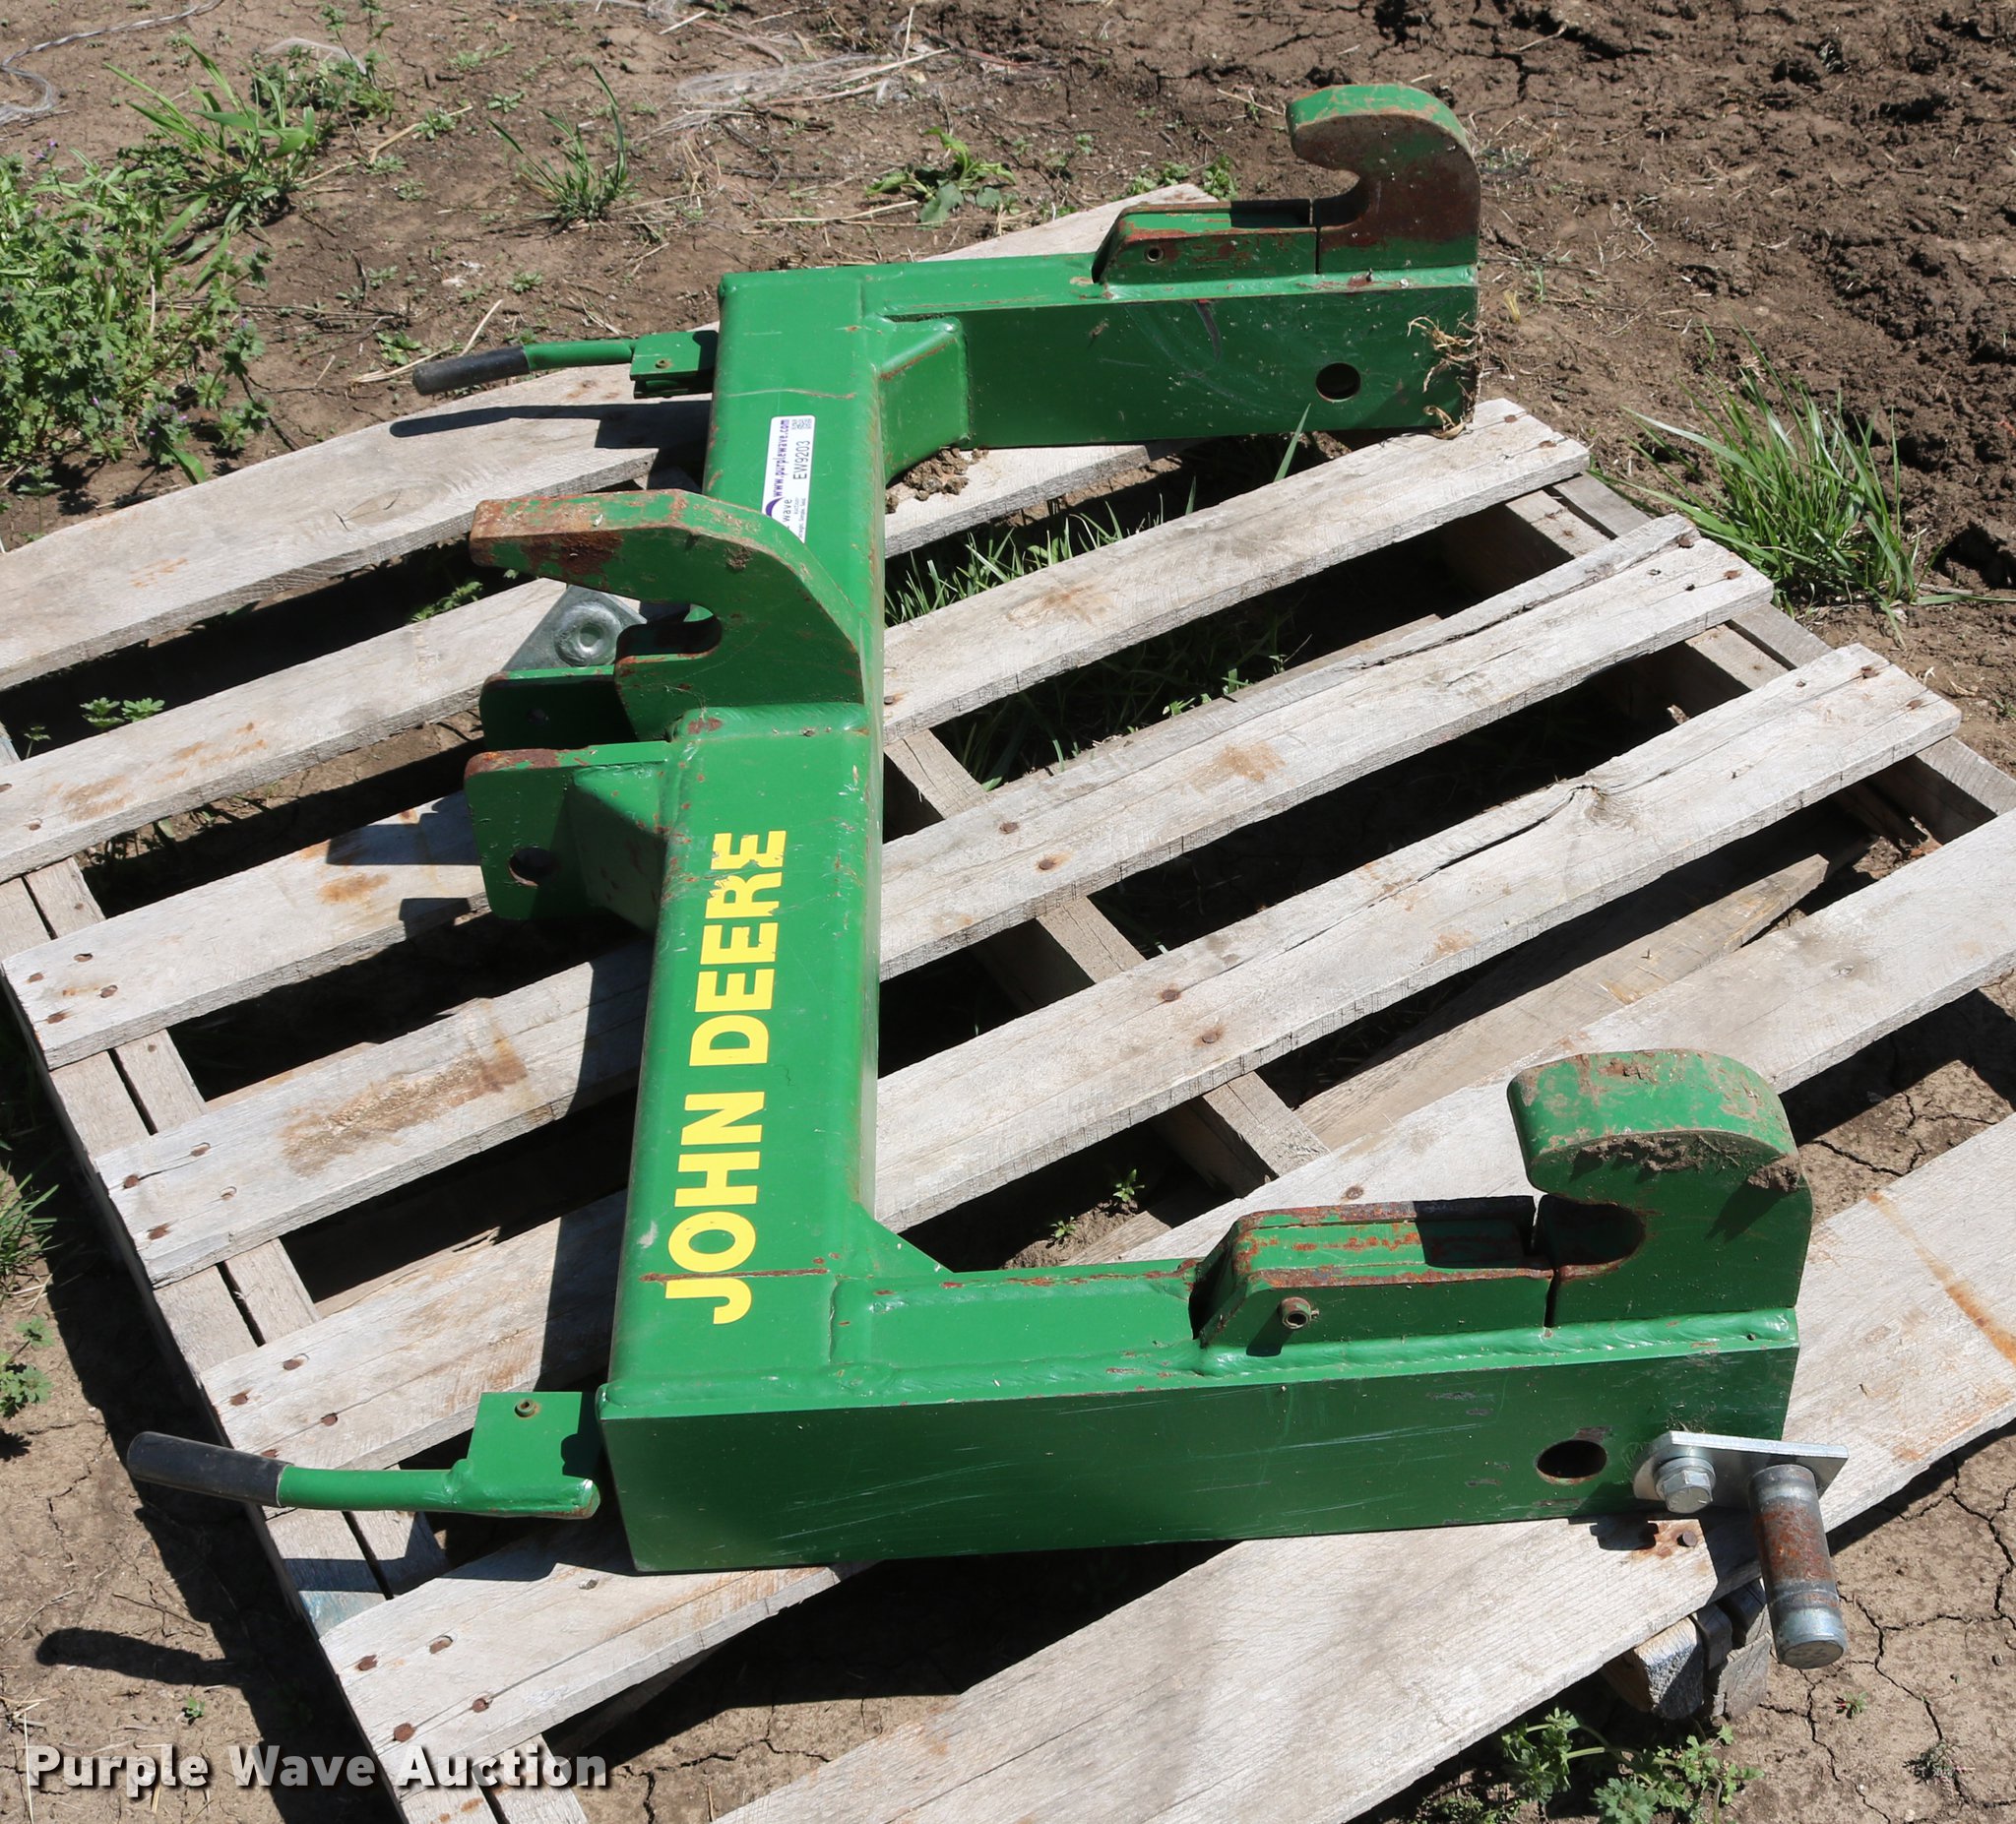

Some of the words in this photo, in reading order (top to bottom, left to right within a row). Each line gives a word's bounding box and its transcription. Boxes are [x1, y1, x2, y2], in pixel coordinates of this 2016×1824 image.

[773, 418, 789, 497] www.purplewave.com
[792, 440, 810, 480] EW9203
[783, 499, 792, 523] wave
[688, 830, 787, 1067] DEERE
[664, 1091, 765, 1325] JOHN
